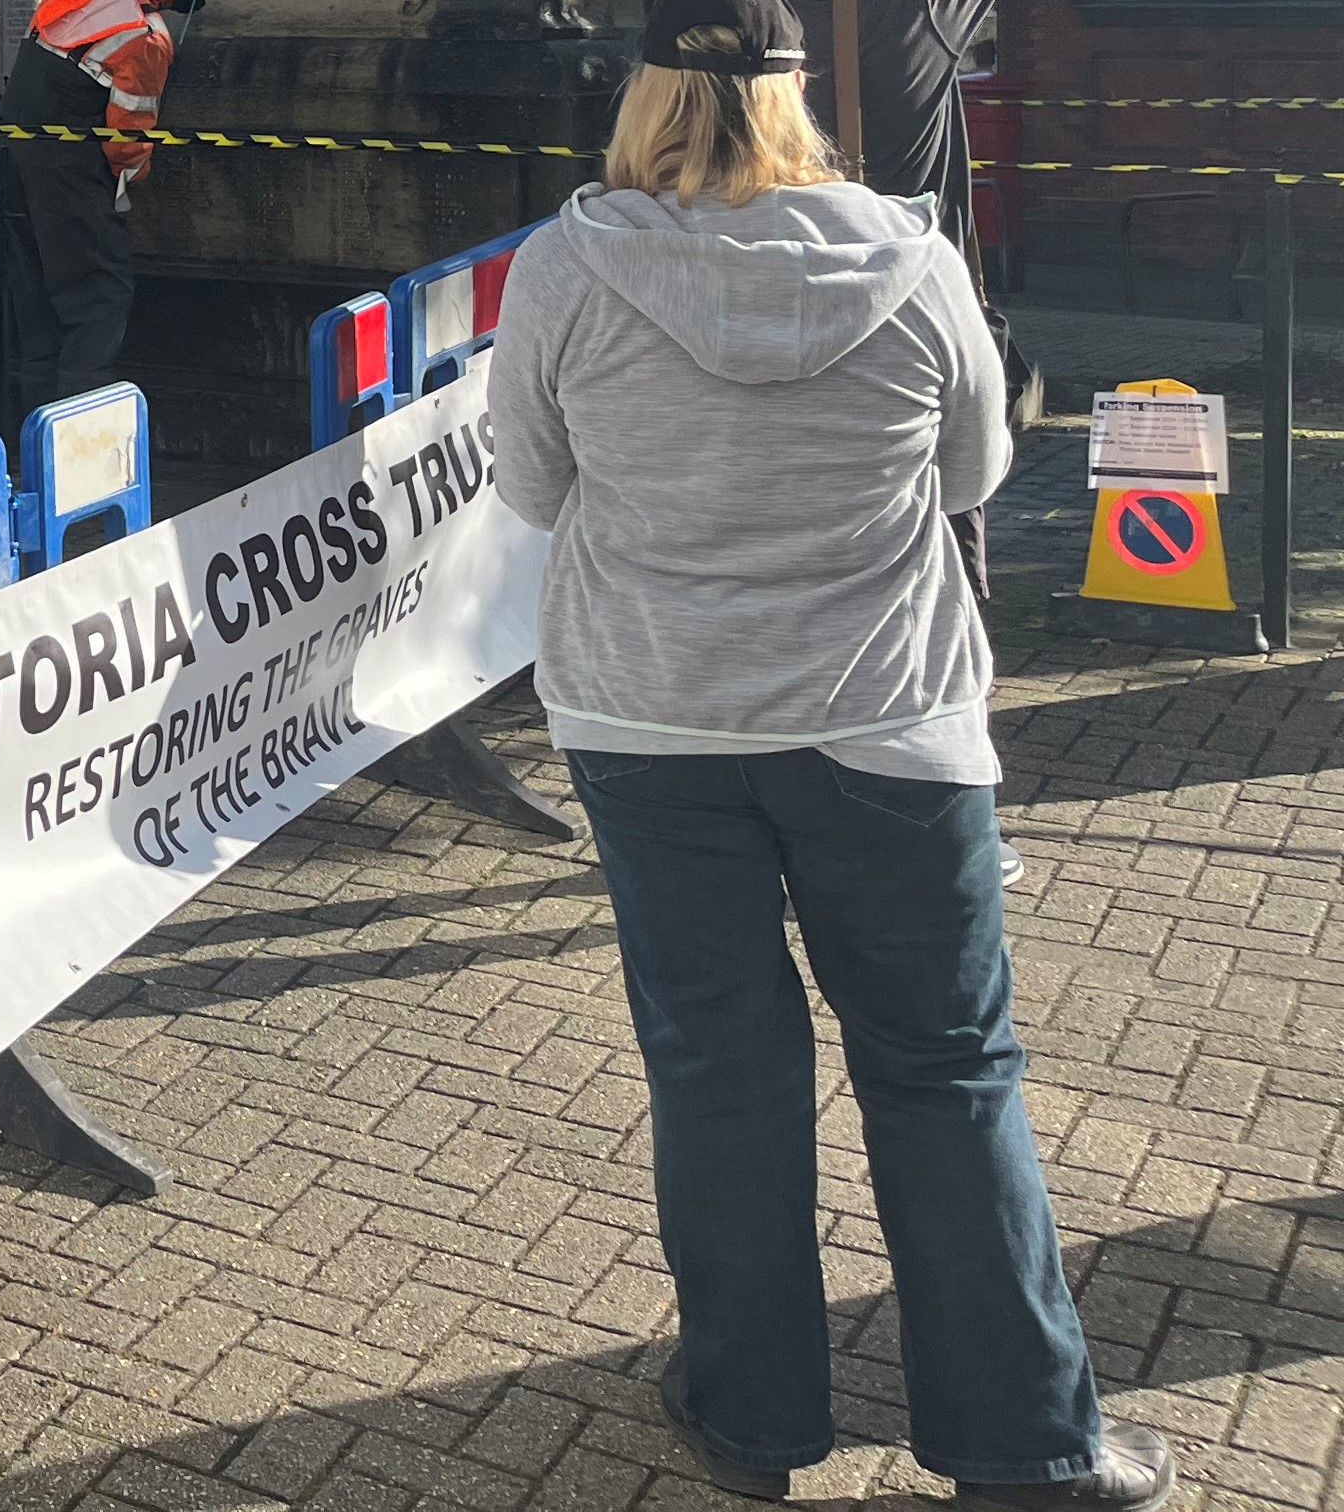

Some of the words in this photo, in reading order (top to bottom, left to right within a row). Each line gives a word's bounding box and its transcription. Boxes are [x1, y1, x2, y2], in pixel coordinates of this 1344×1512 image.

[205, 481, 387, 644] CROSS
[25, 672, 253, 842] RESTORING
[262, 629, 324, 714] THE
[326, 561, 428, 670] GRAVES
[133, 791, 189, 868] OF
[190, 745, 262, 834] THE
[260, 675, 367, 789] BRAVE
